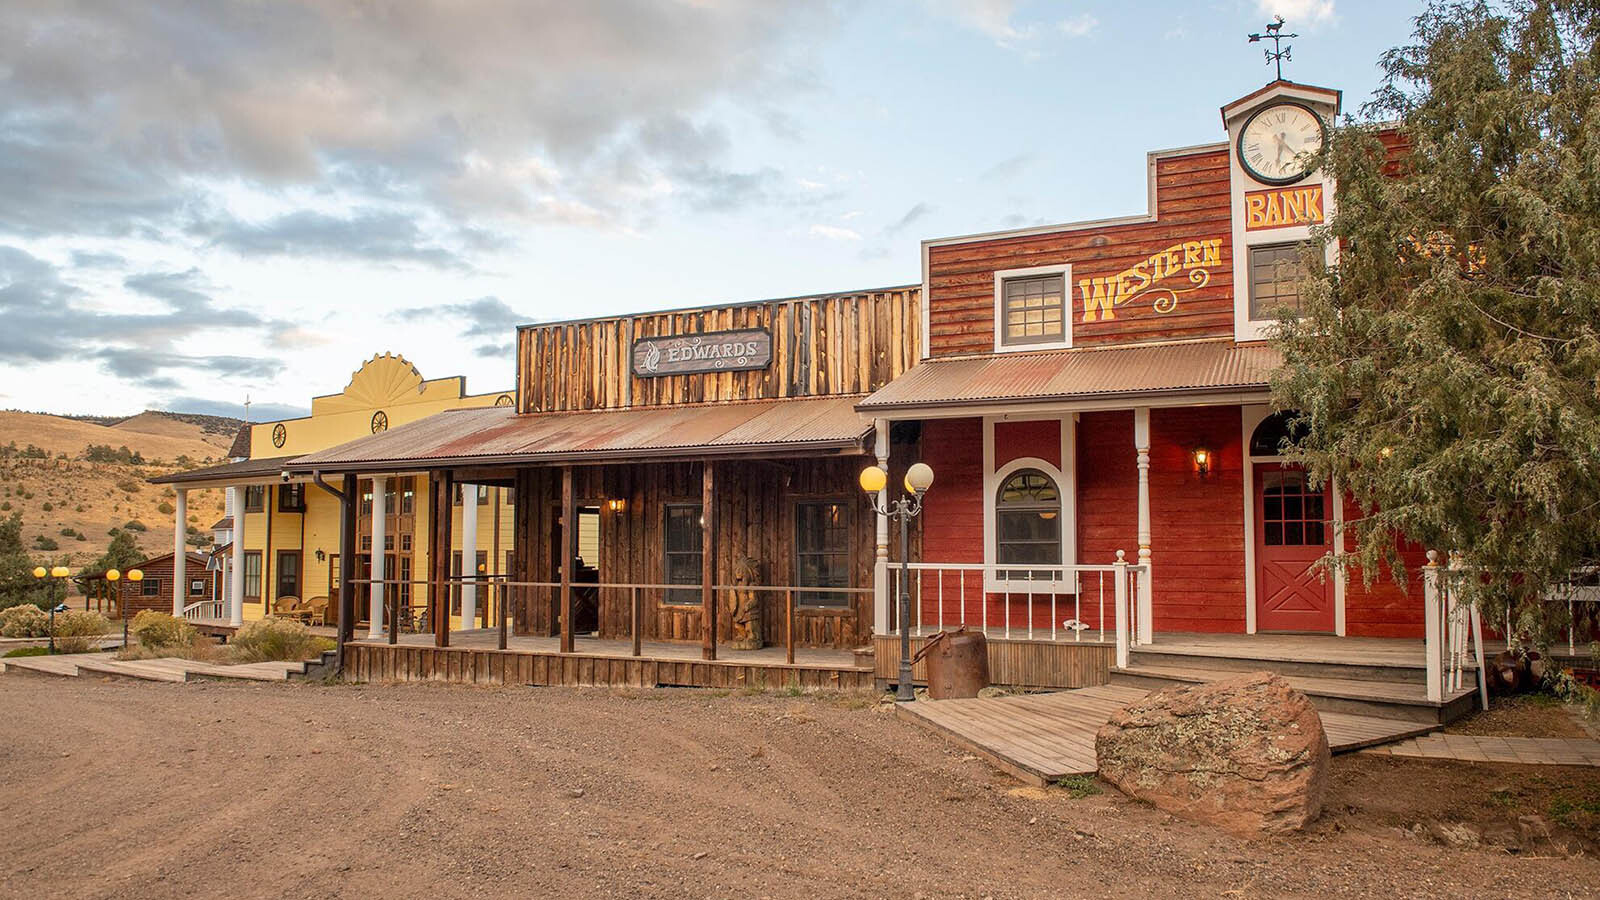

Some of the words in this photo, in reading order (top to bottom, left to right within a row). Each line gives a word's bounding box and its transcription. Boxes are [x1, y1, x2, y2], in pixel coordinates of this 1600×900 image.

[1246, 188, 1324, 228] BANK
[1079, 239, 1223, 322] WESTERN
[668, 341, 758, 363] EDWARDS
